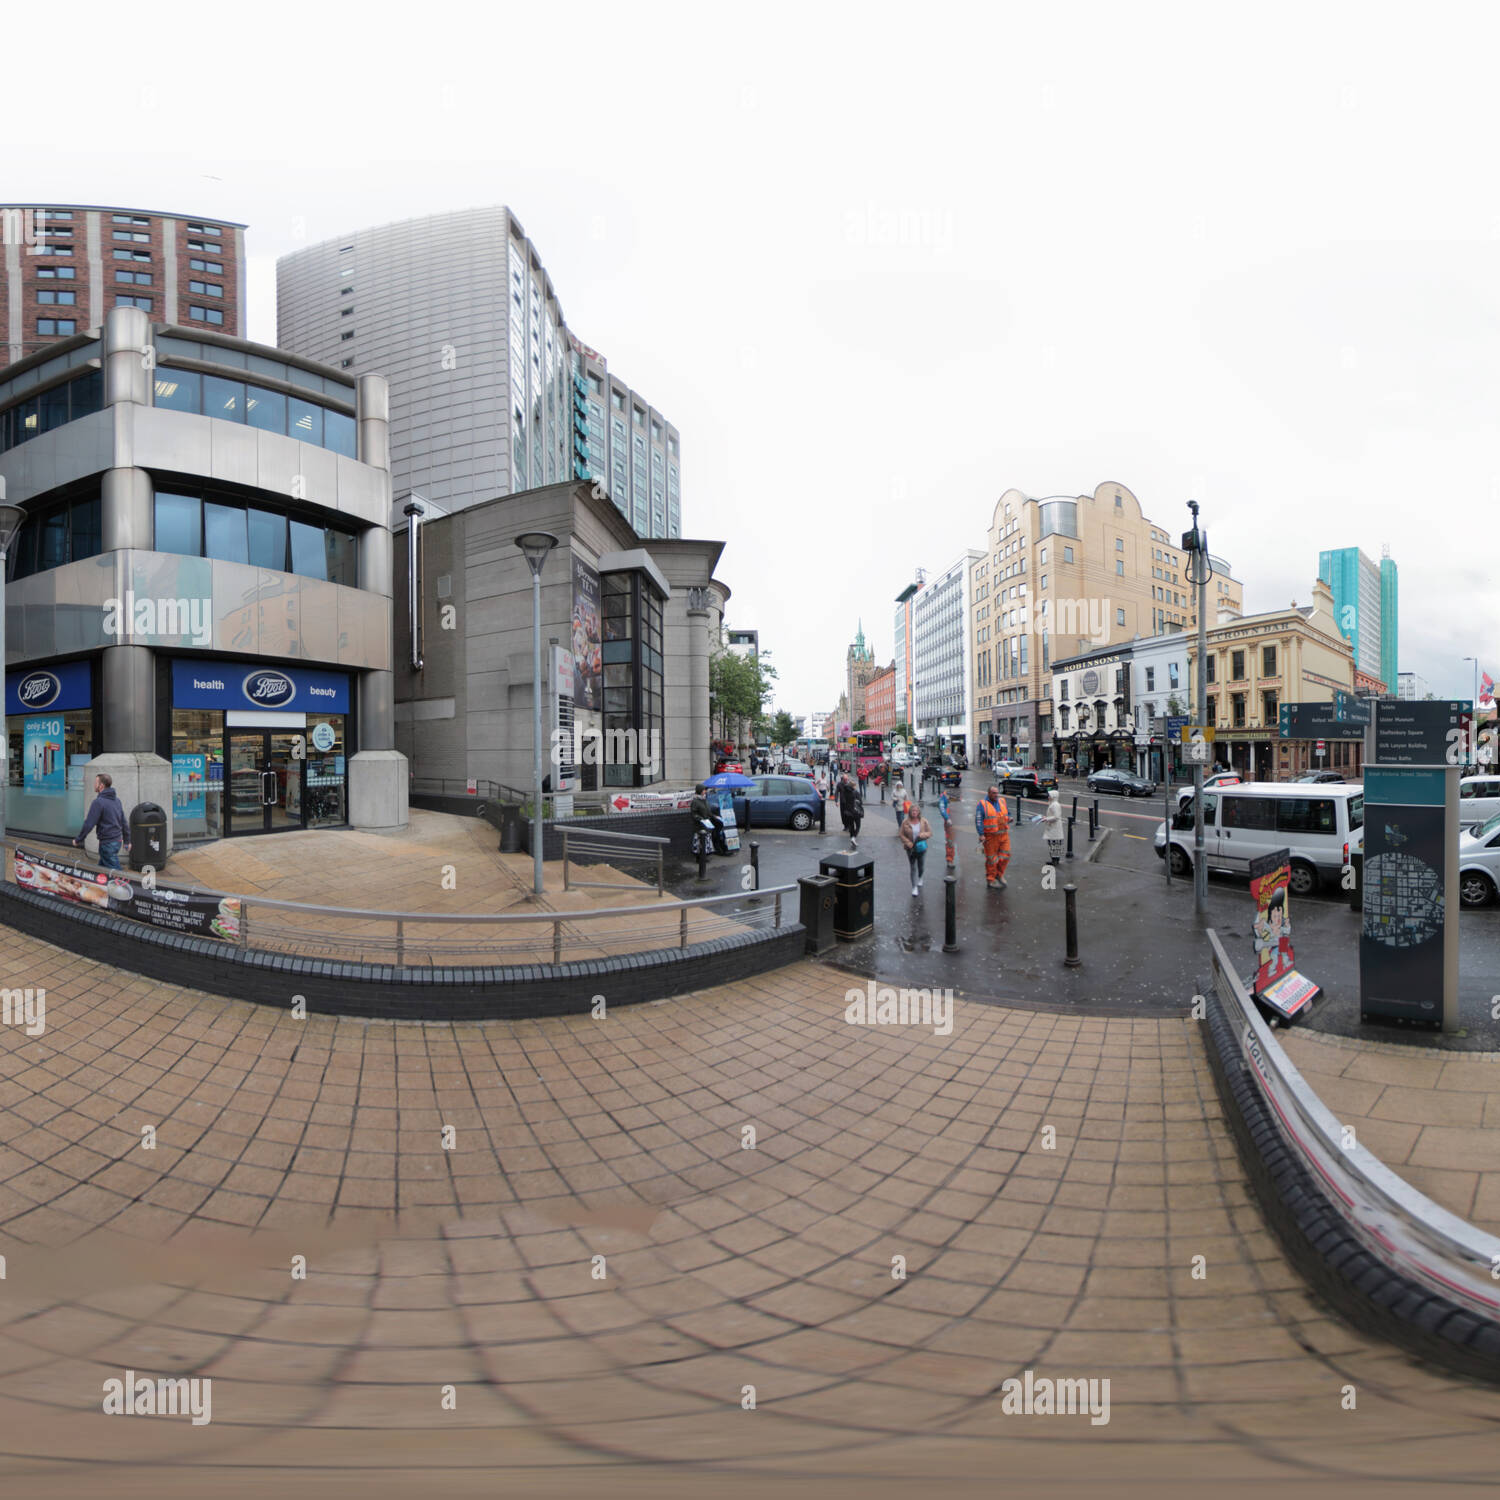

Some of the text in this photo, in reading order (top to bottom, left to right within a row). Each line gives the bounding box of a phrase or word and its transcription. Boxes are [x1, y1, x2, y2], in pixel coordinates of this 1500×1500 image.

[1216, 627, 1259, 641] CROWN
[1263, 622, 1289, 633] BAR
[1064, 655, 1120, 672] ROBINSONS
[22, 678, 51, 700] Boots
[194, 679, 225, 690] health
[252, 677, 288, 698] Boots
[310, 686, 336, 698] beauty
[41, 720, 61, 736] £10
